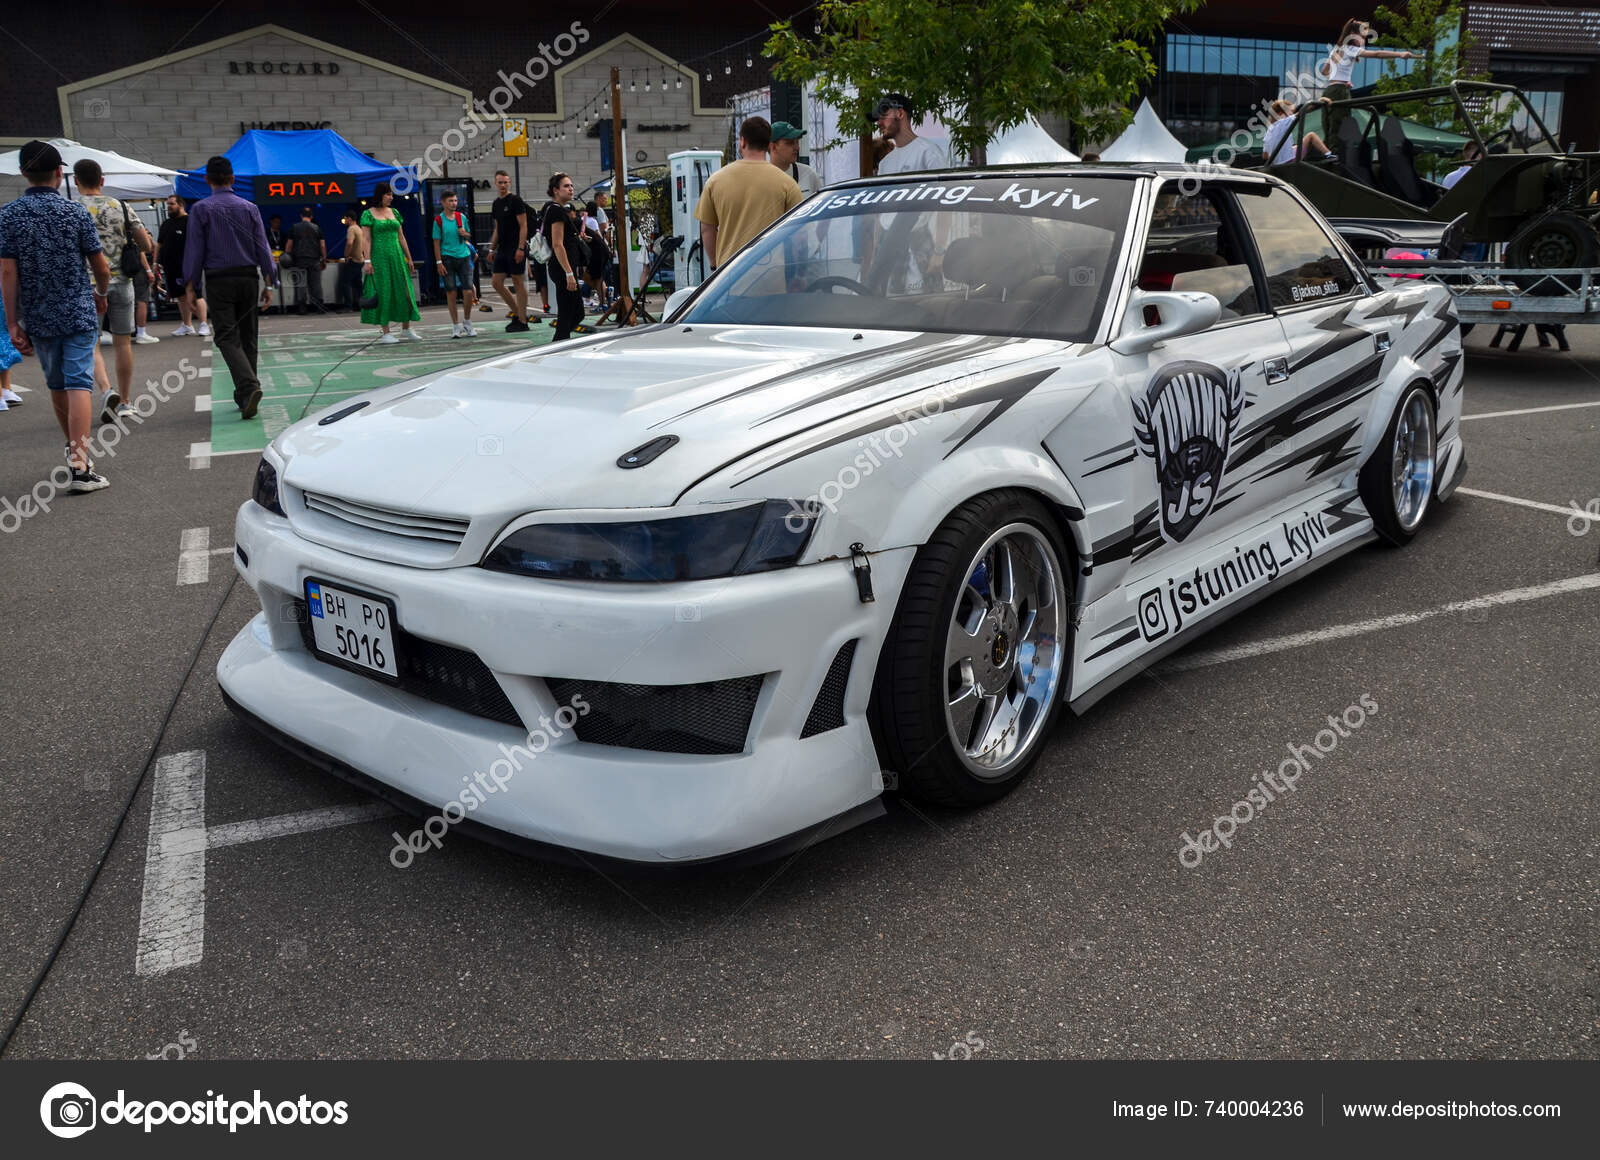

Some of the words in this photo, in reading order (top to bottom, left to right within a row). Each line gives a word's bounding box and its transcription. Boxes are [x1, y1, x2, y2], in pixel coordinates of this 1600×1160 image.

[228, 61, 340, 76] BROCARD
[268, 181, 343, 197] ЯЛТА
[1150, 372, 1229, 473] TUNING
[1167, 471, 1213, 524] JS
[1168, 511, 1327, 634] jstuning_kyiv
[325, 592, 347, 619] BH
[335, 624, 386, 668] 5016
